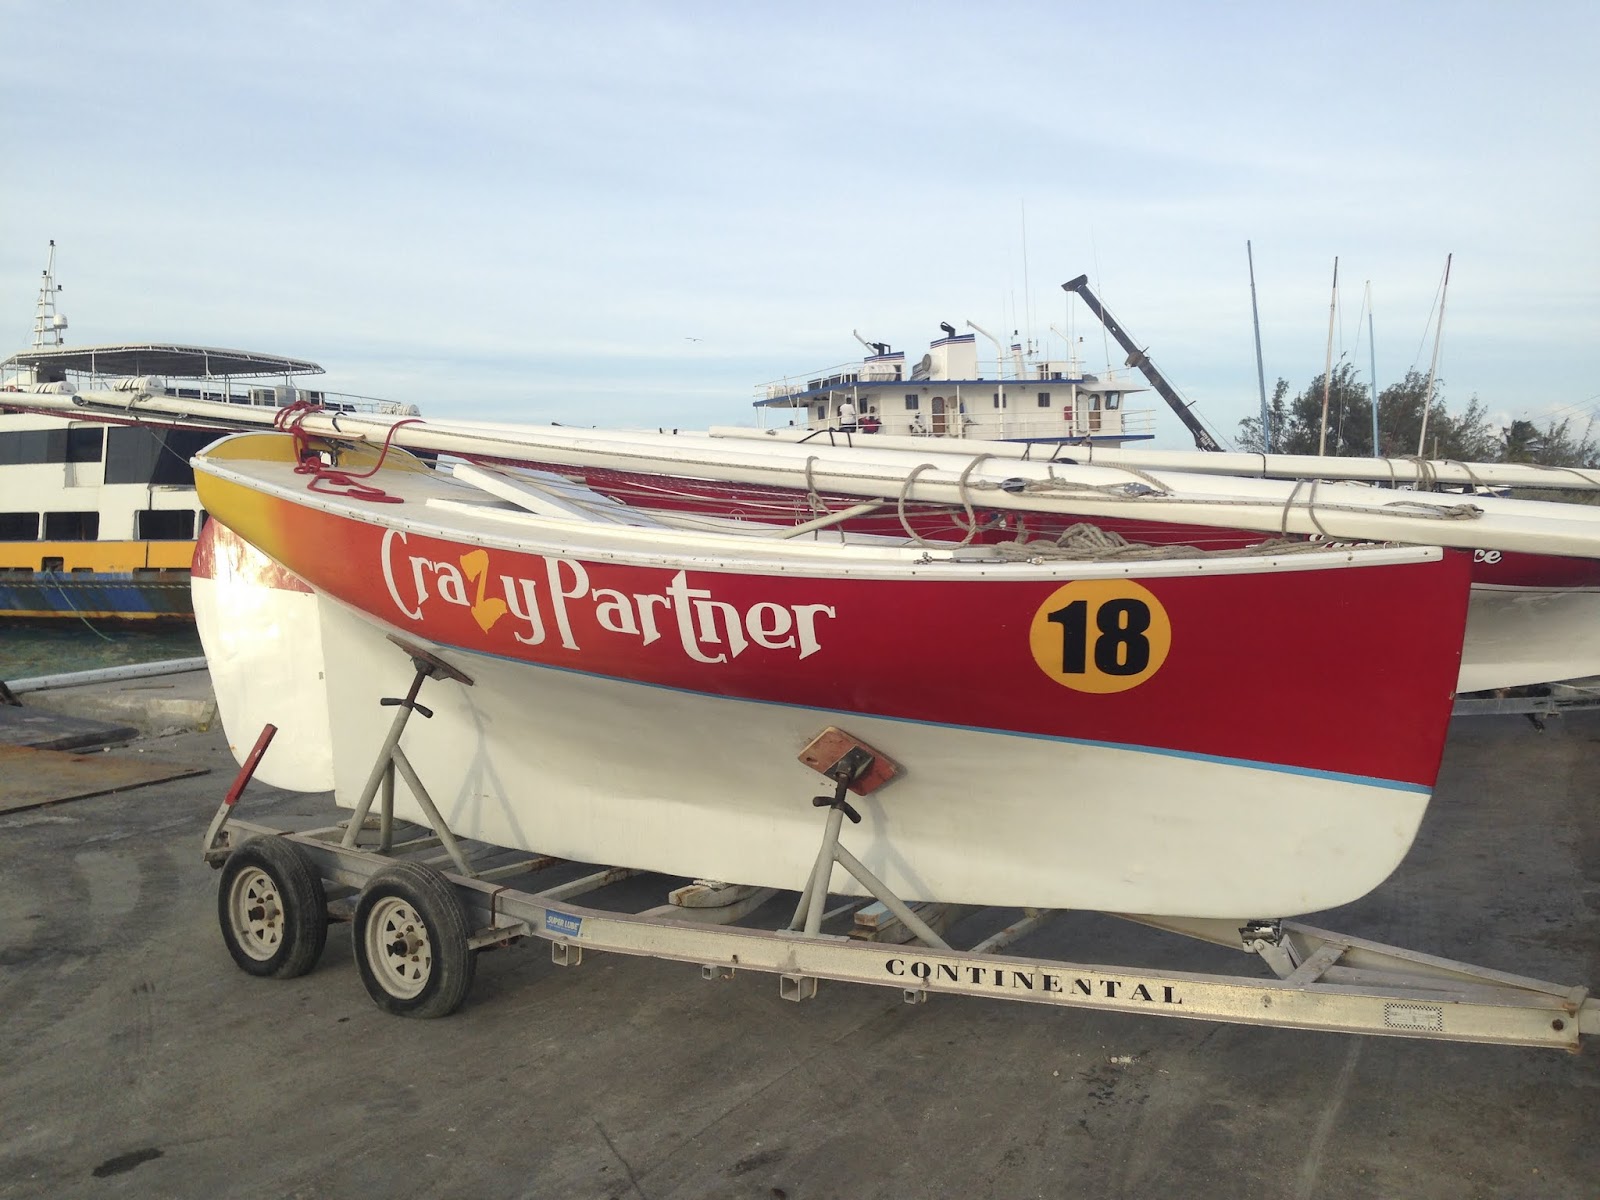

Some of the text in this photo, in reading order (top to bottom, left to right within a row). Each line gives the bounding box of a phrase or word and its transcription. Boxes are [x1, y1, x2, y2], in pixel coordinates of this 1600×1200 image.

[543, 556, 836, 663] Partner
[1047, 598, 1151, 676] 18
[885, 958, 1183, 1005] CONTINENTAL
